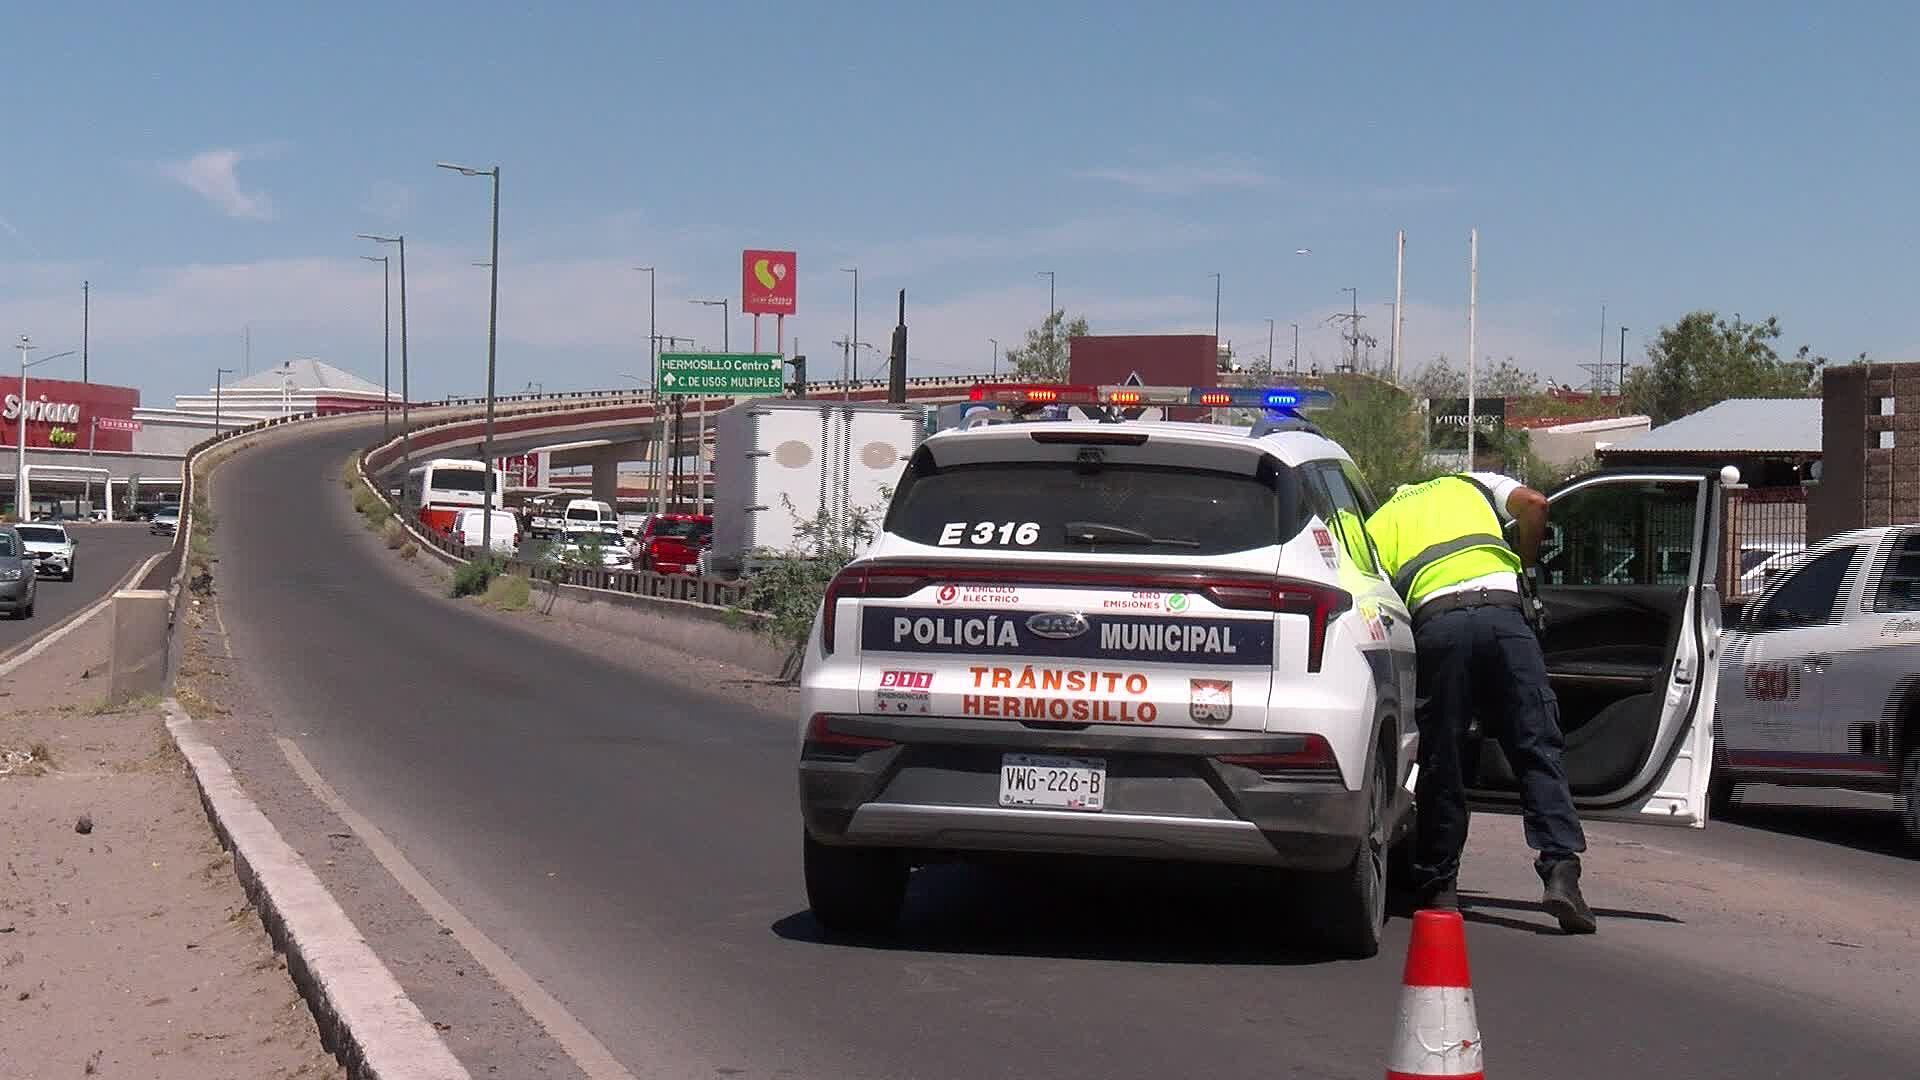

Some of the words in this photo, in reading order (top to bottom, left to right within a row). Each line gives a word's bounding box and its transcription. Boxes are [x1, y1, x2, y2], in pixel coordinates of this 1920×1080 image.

[662, 360, 731, 370] HERMOSILLO
[734, 360, 769, 370] Centro
[688, 376, 700, 387] DE
[702, 376, 727, 387] USOS
[938, 522, 968, 546] E
[971, 521, 1041, 546] 316
[1103, 600, 1160, 609] EMISIONES
[1132, 592, 1161, 600] CERO
[894, 615, 1019, 647] POLICÍA
[1101, 623, 1237, 653] MUNICIPAL
[883, 672, 930, 688] 911
[969, 665, 1149, 694] TRÁNSITO
[962, 694, 1158, 723] HERMOSILLO
